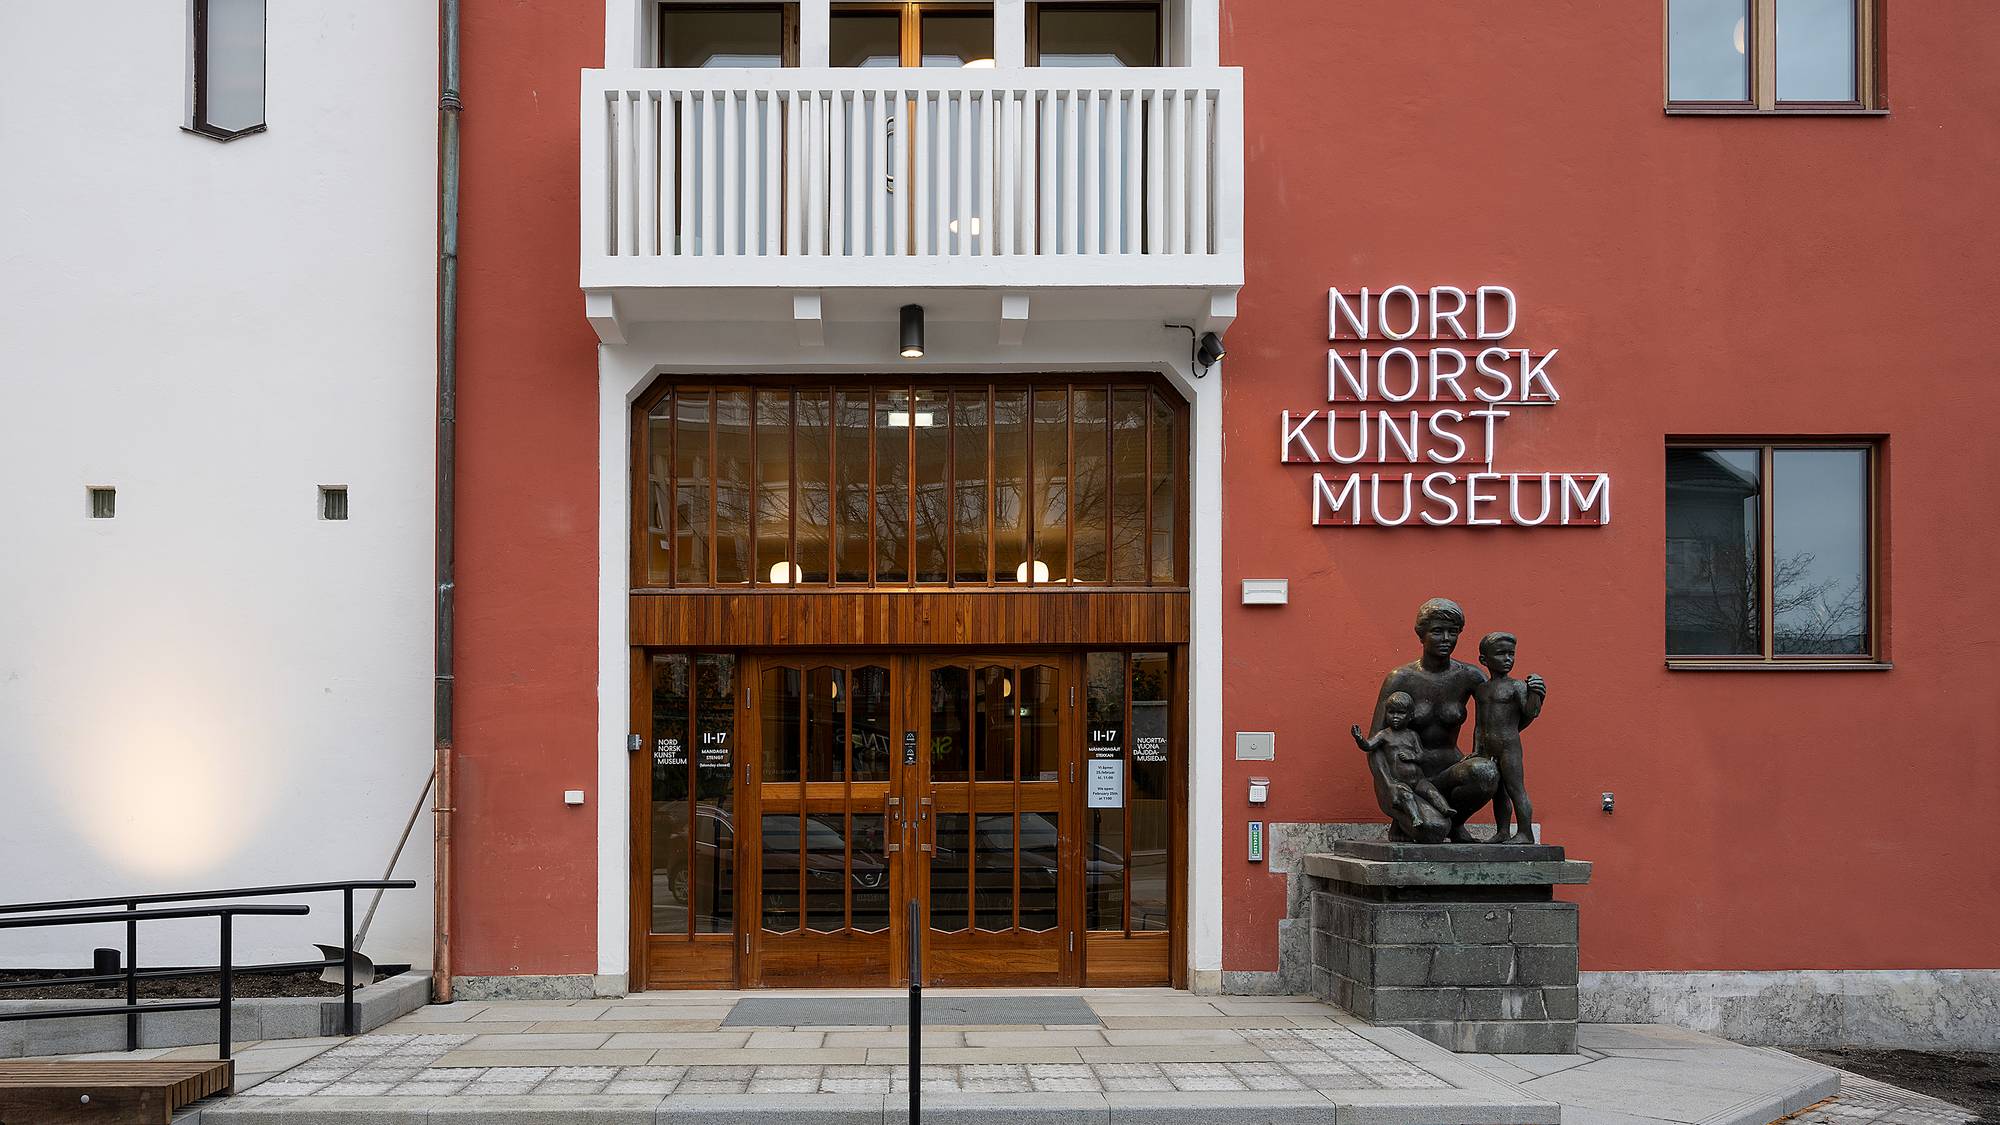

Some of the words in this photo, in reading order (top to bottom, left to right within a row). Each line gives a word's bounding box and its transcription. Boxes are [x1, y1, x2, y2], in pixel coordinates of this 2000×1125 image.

[1328, 285, 1517, 340] NORD
[1328, 347, 1560, 402] NORSK
[1281, 409, 1510, 464] KUNST
[1312, 471, 1610, 526] MUSEUM
